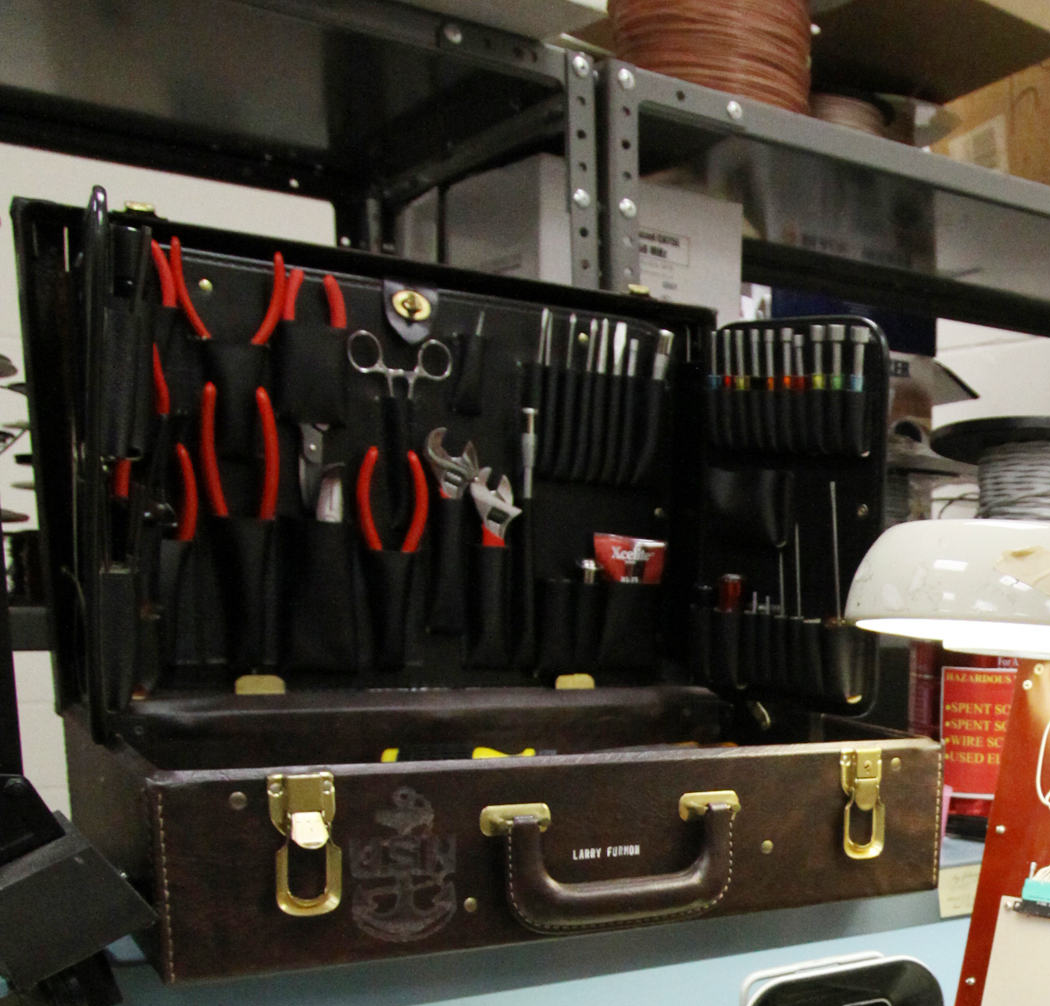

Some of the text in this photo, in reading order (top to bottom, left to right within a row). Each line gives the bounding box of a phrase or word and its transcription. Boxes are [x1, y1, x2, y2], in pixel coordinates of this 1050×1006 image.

[946, 672, 1013, 684] HAZARDOUS
[951, 702, 992, 715] SPENT
[950, 718, 992, 731] SPENT
[950, 735, 983, 747] WIRE
[950, 752, 985, 764] USED
[572, 842, 602, 860] LARRY
